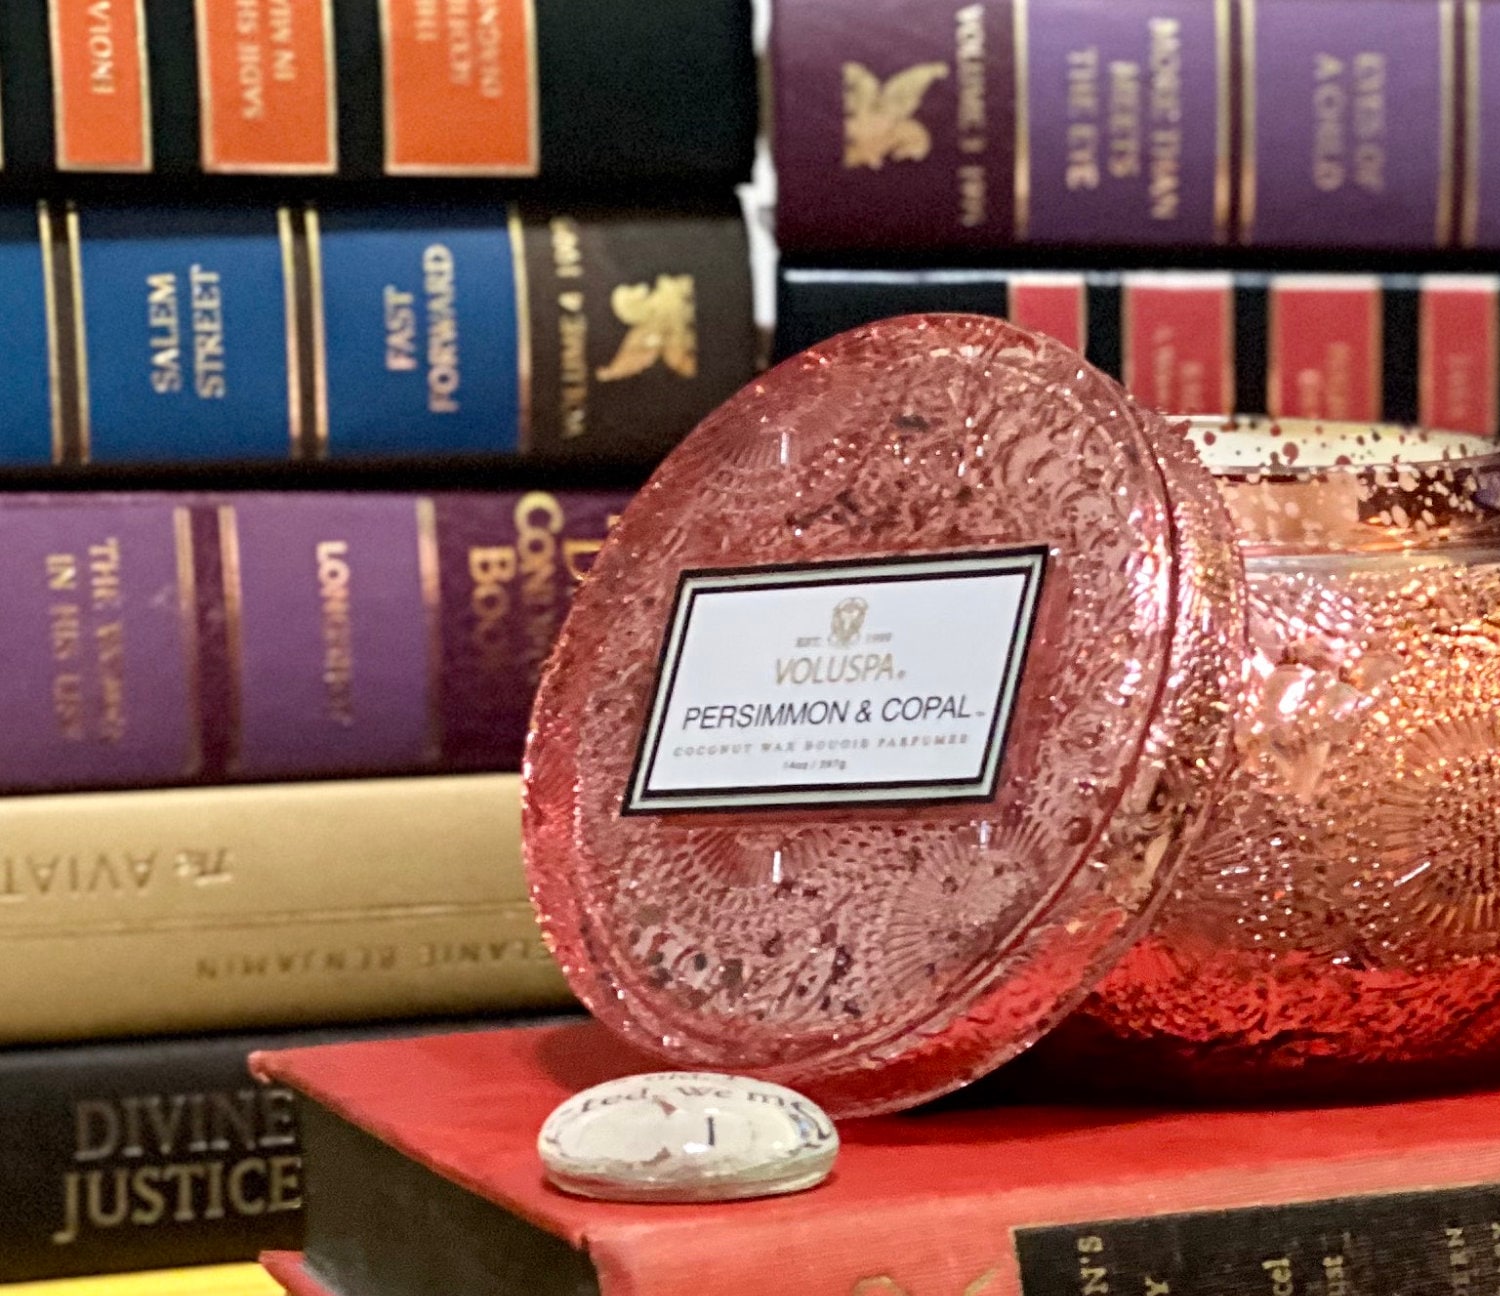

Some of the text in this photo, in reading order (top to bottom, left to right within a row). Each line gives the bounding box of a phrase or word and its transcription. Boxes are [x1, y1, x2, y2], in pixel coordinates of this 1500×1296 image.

[273, 50, 296, 82] IN
[1065, 48, 1098, 118] THE
[1107, 61, 1140, 178] MEETS
[1313, 53, 1342, 193] A CHILD
[1147, 130, 1181, 220] THAN
[148, 272, 179, 394] SALEM
[190, 264, 226, 400] STREET
[385, 286, 415, 372] FAST
[424, 245, 459, 412] FORWARD
[559, 314, 587, 439] VOLUME
[45, 554, 77, 589] IN
[88, 538, 121, 609] THE
[673, 743, 753, 757] COCONUT
[682, 699, 850, 730] PERSIMMON
[855, 700, 872, 722] &
[195, 944, 398, 983] BENJAMIN
[74, 1089, 296, 1162] DIVINE
[52, 1157, 301, 1244] JUSTICE
